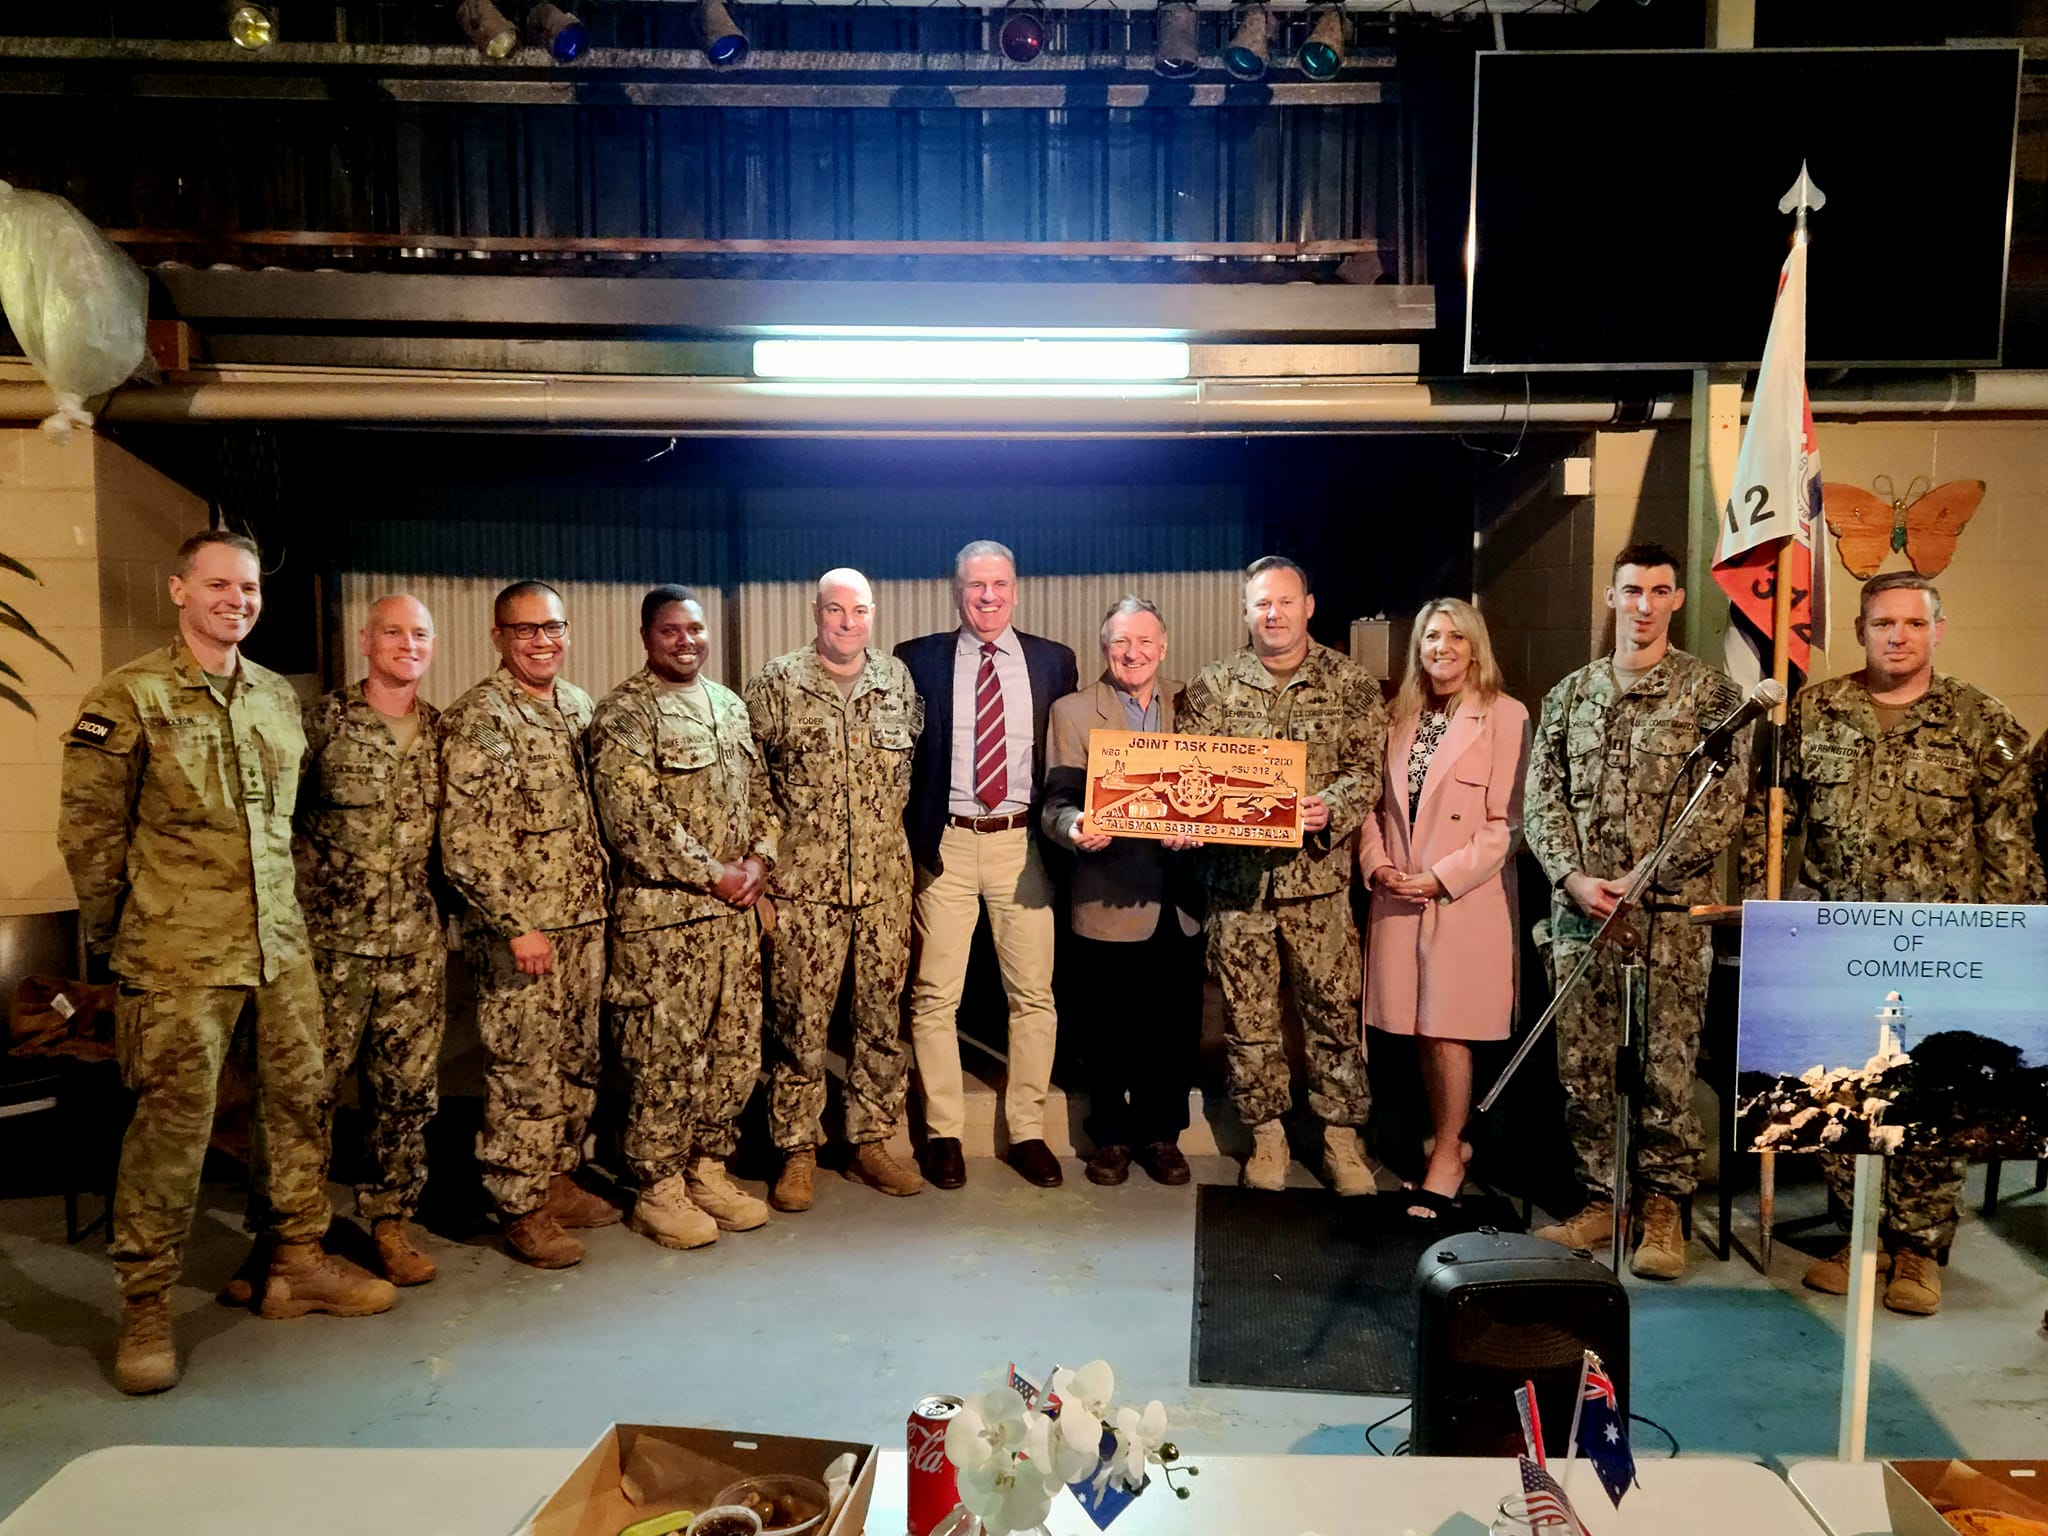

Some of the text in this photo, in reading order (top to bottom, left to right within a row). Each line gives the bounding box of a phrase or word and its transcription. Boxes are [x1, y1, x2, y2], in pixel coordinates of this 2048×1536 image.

[797, 717, 824, 726] YODER
[1648, 719, 1669, 728] COAST
[1128, 738, 1169, 751] JOINT
[1174, 740, 1207, 753] TASK
[1106, 819, 1290, 840] TALISMAN SABRE 23 AUSTRALIA
[1817, 908, 2027, 929] BOWEN CHAMBER
[1893, 935, 1925, 952] OF
[1847, 959, 1984, 979] COMMERCE
